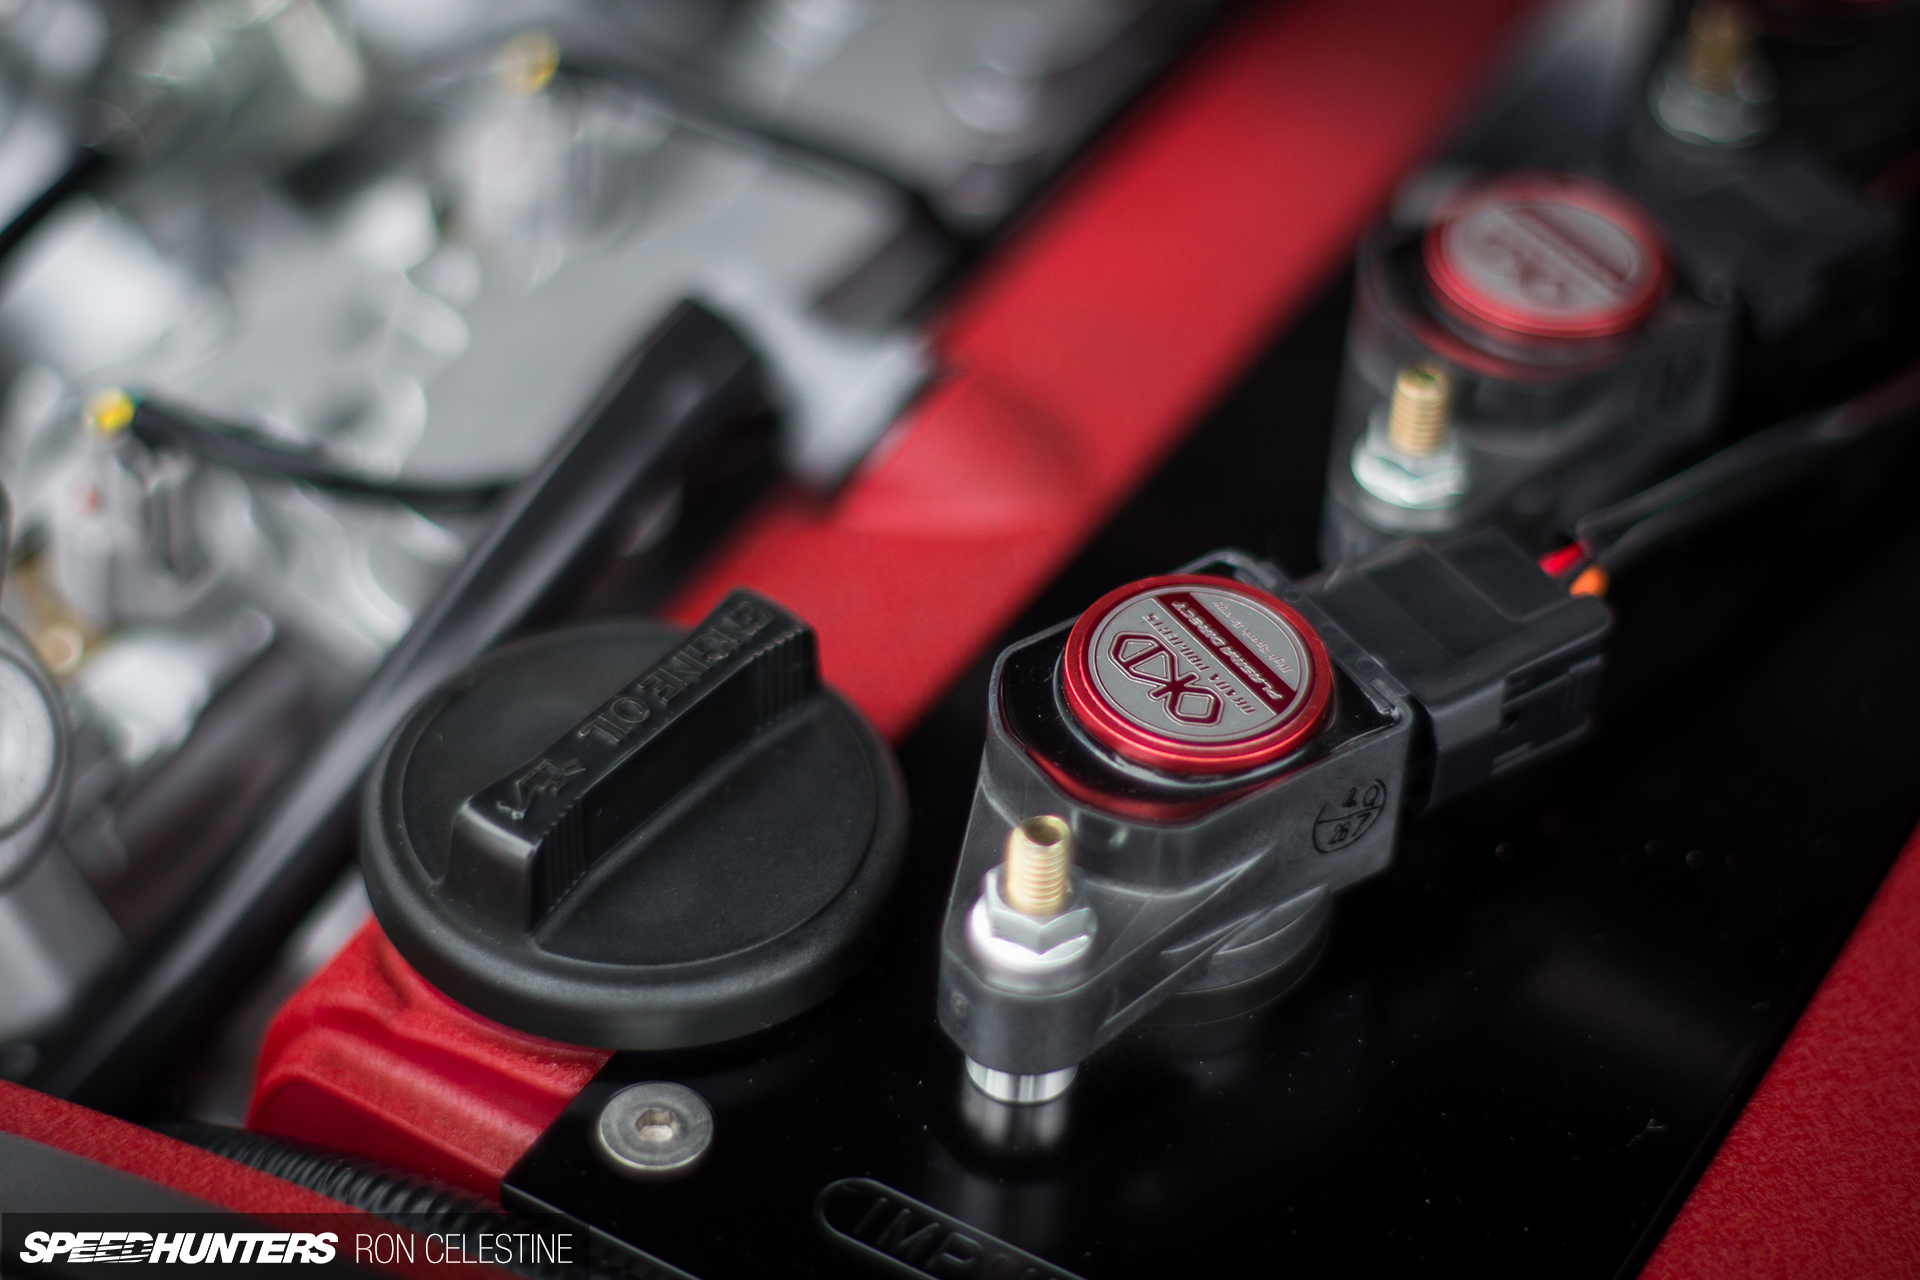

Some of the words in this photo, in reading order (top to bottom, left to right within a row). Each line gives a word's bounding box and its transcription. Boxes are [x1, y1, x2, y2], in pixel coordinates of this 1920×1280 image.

[1171, 600, 1229, 648] DIRECT
[1212, 600, 1244, 629] Energy
[637, 600, 773, 705] ENGINE
[1141, 613, 1210, 672] PROJECTS
[1241, 628, 1270, 653] Spark
[1269, 653, 1292, 674] High
[1107, 631, 1225, 727] OKD
[1207, 673, 1256, 715] OKADA
[1219, 645, 1285, 701] PLASMA
[577, 696, 650, 744] OIL
